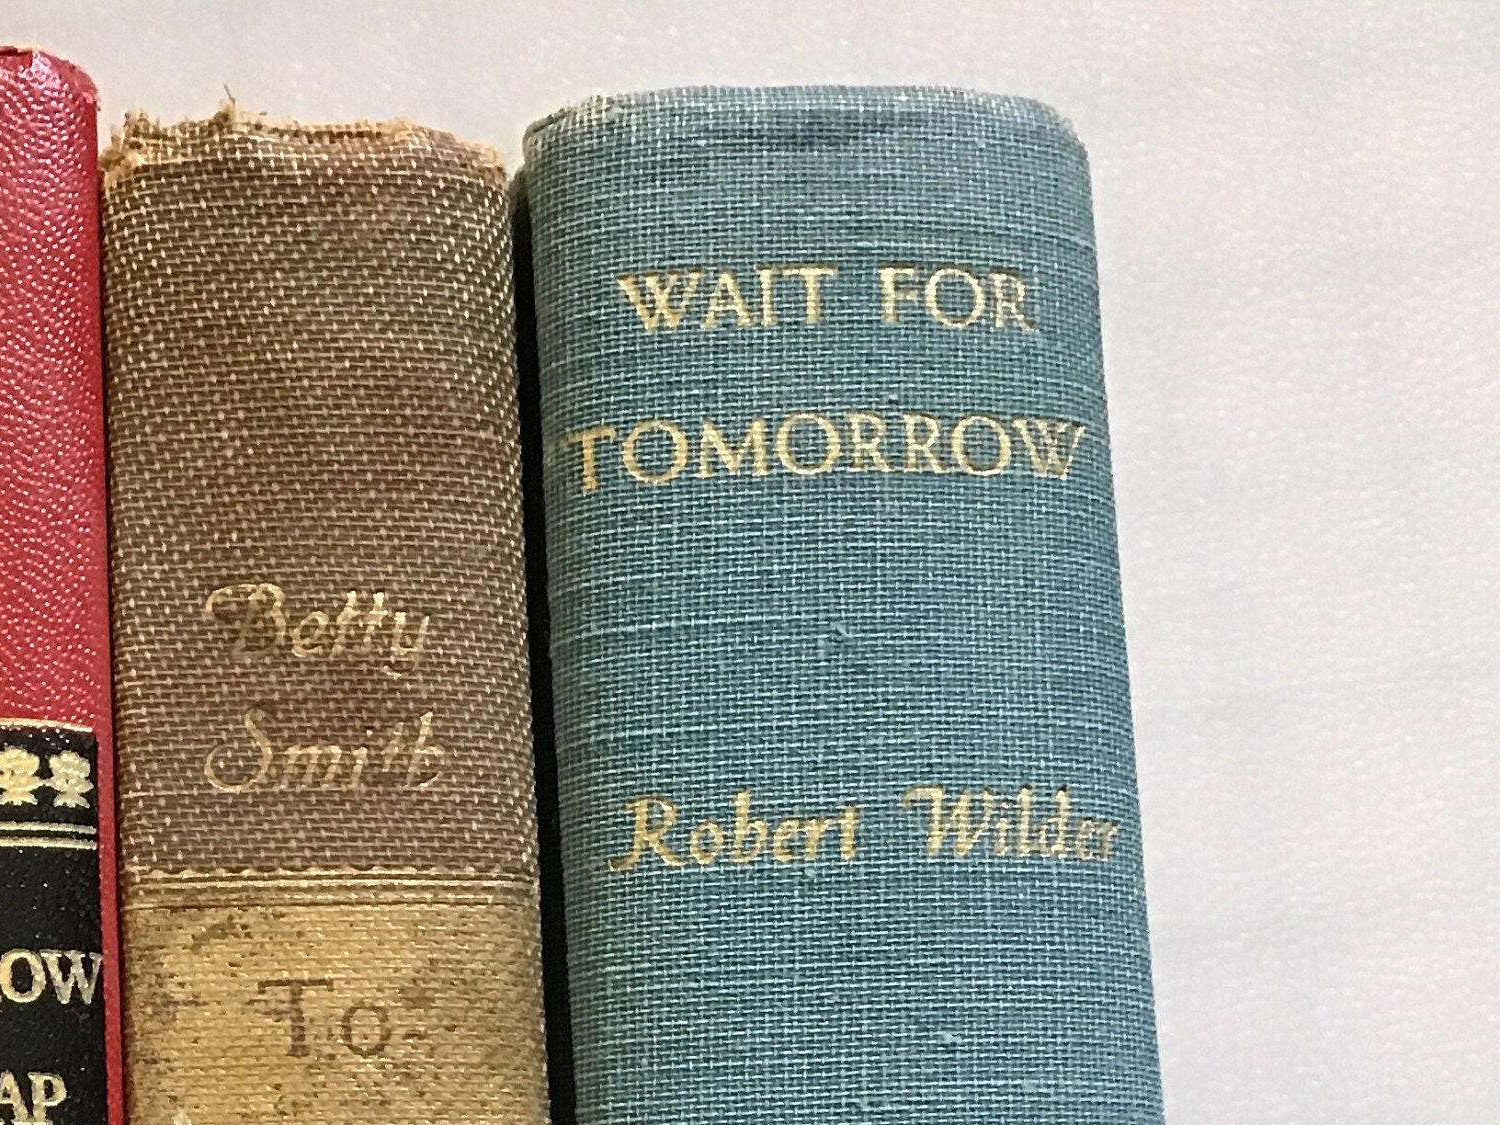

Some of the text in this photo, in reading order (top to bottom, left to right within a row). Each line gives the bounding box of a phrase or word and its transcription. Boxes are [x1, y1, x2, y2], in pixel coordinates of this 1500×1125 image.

[615, 263, 1040, 333] WAIT FOR
[568, 411, 1085, 492] TOMORROW
[206, 582, 431, 677] Betty
[608, 782, 1122, 872] Robert Wilder
[257, 977, 426, 1058] To-
